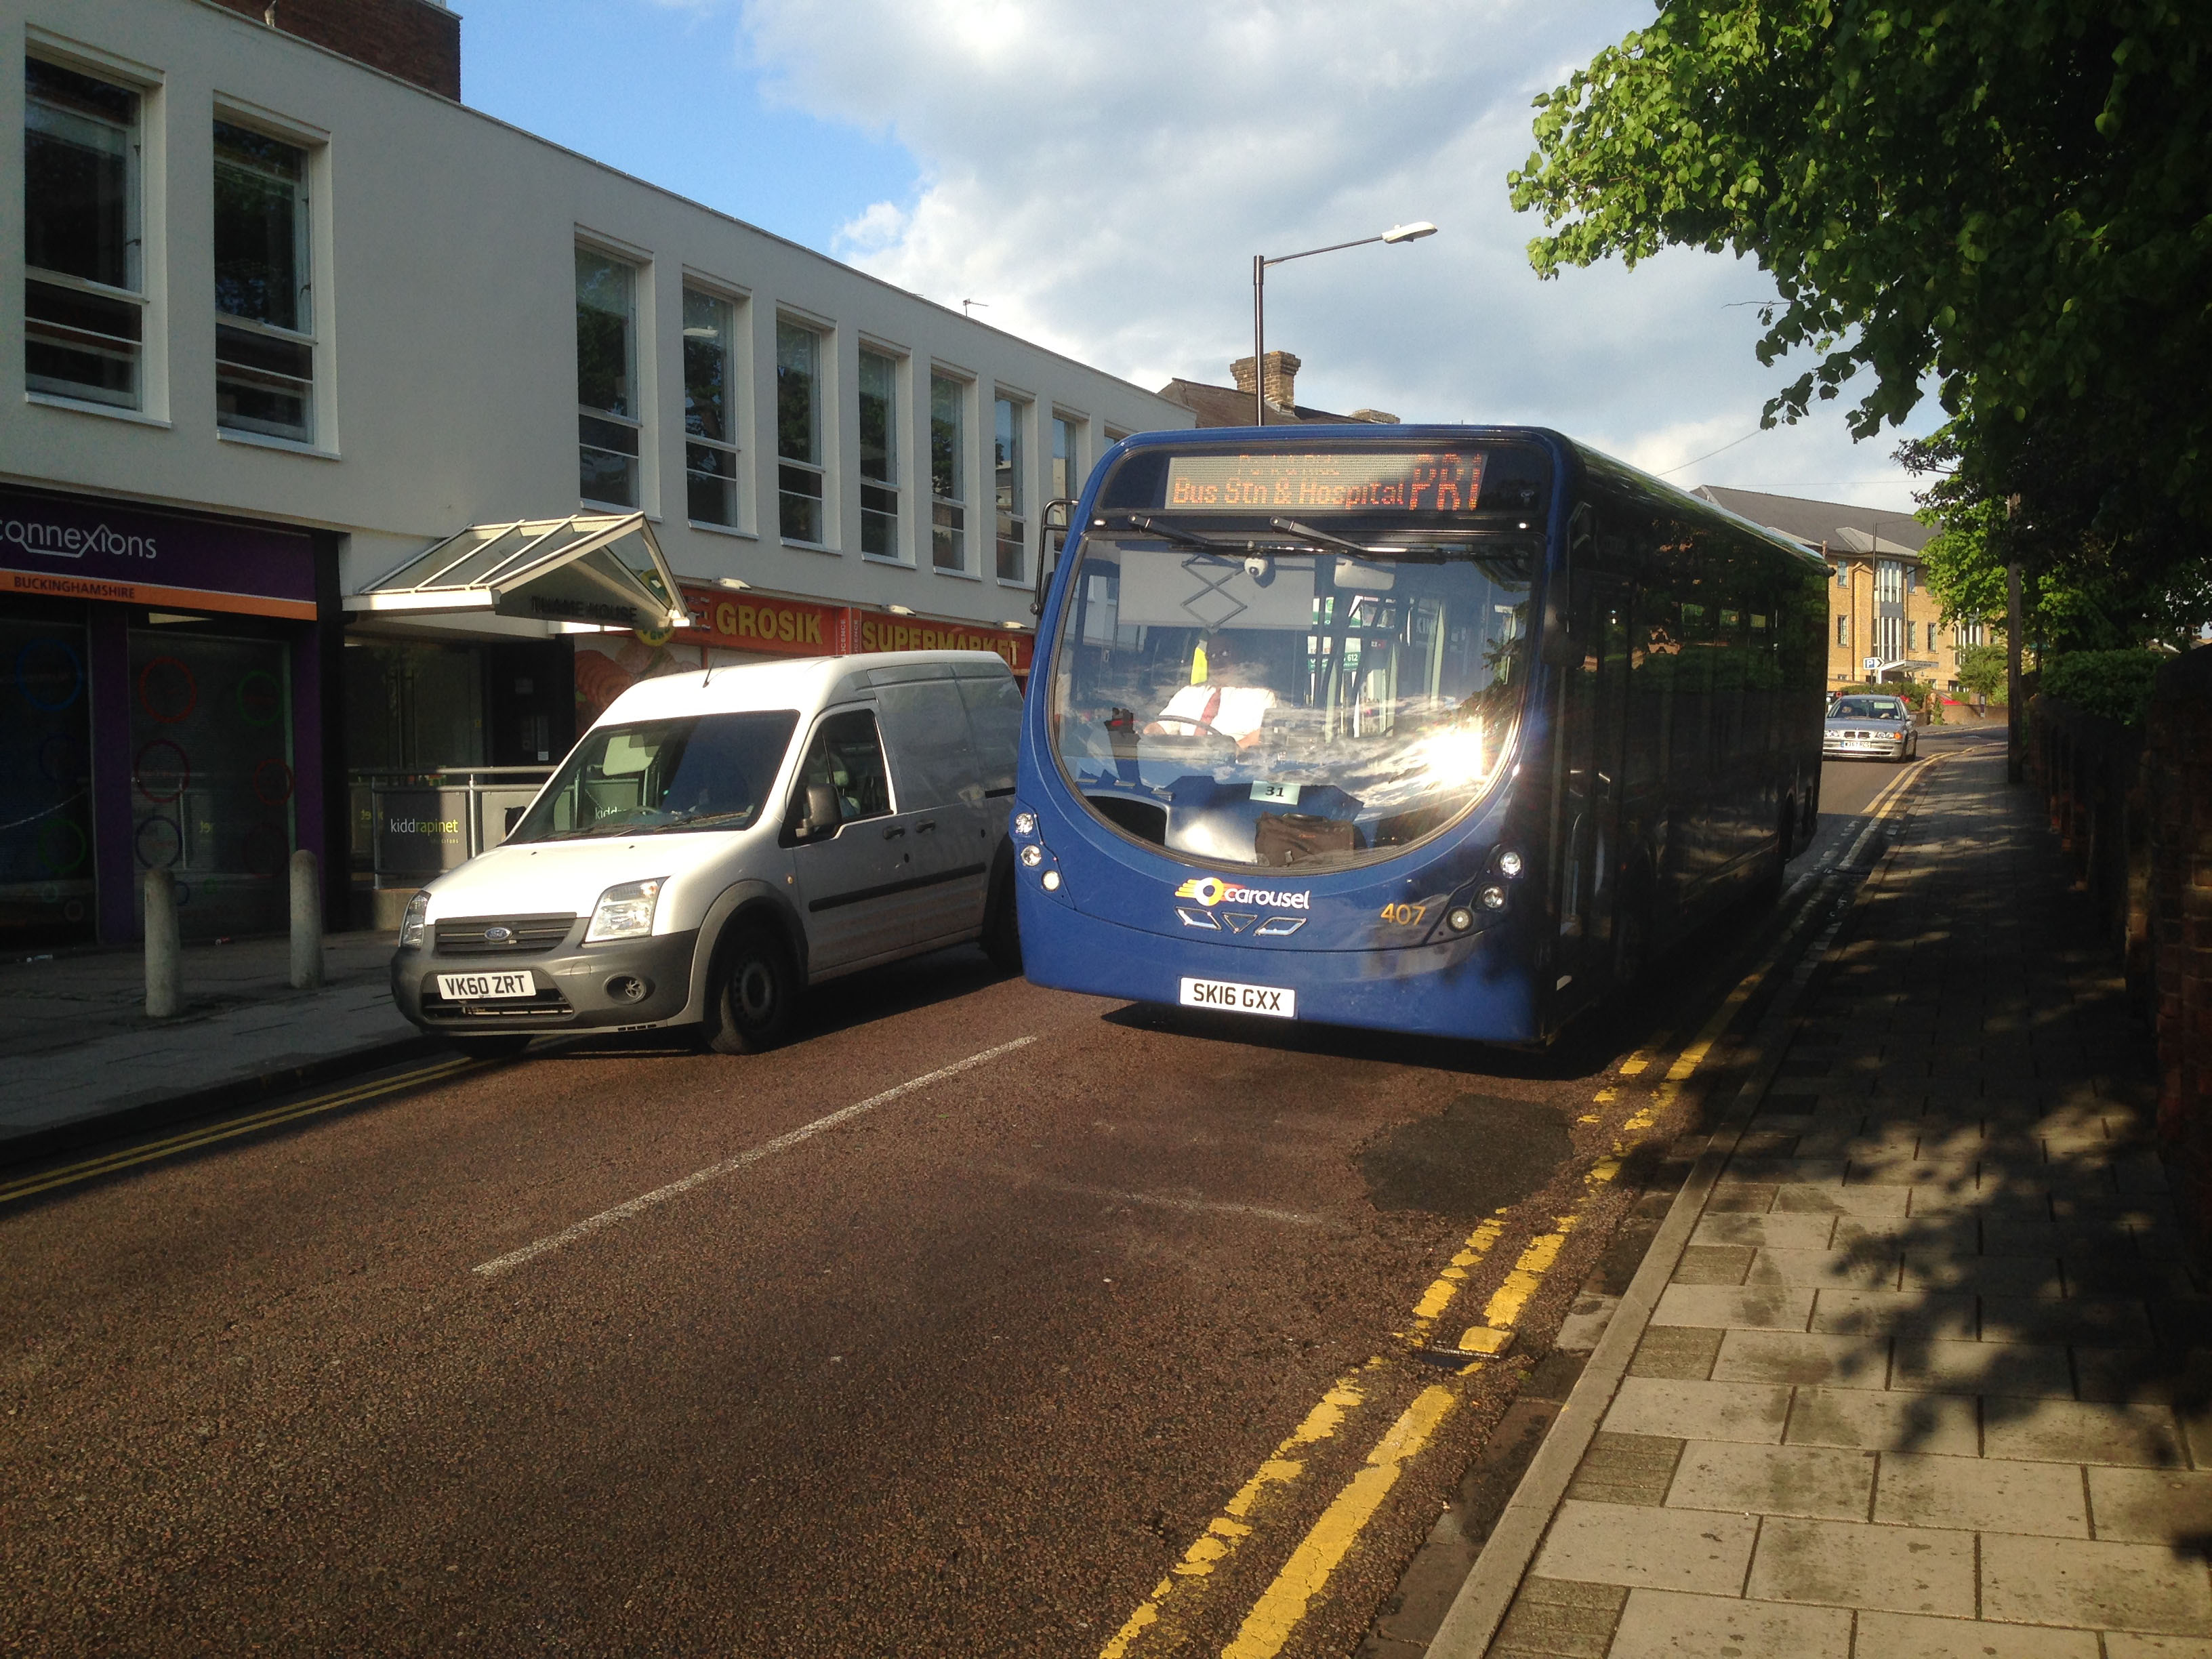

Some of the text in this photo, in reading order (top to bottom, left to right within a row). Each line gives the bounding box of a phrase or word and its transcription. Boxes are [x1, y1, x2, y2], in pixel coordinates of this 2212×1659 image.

[1172, 478, 1218, 504] Bus
[1223, 476, 1269, 504] Stn
[1273, 476, 1293, 504] &
[1297, 475, 1406, 510] Hospital
[14, 577, 135, 598] BUCKINGHAMSHIRE
[716, 602, 823, 644] GROSIK
[863, 621, 1020, 665] SUPERMARKET
[1265, 786, 1284, 797] 31
[390, 818, 459, 837] kiddrapinet
[1224, 889, 1310, 909] carousel
[1380, 903, 1426, 926] 407
[445, 975, 525, 996] VK60 ZRT
[1193, 983, 1281, 1011] SK16 GXX
